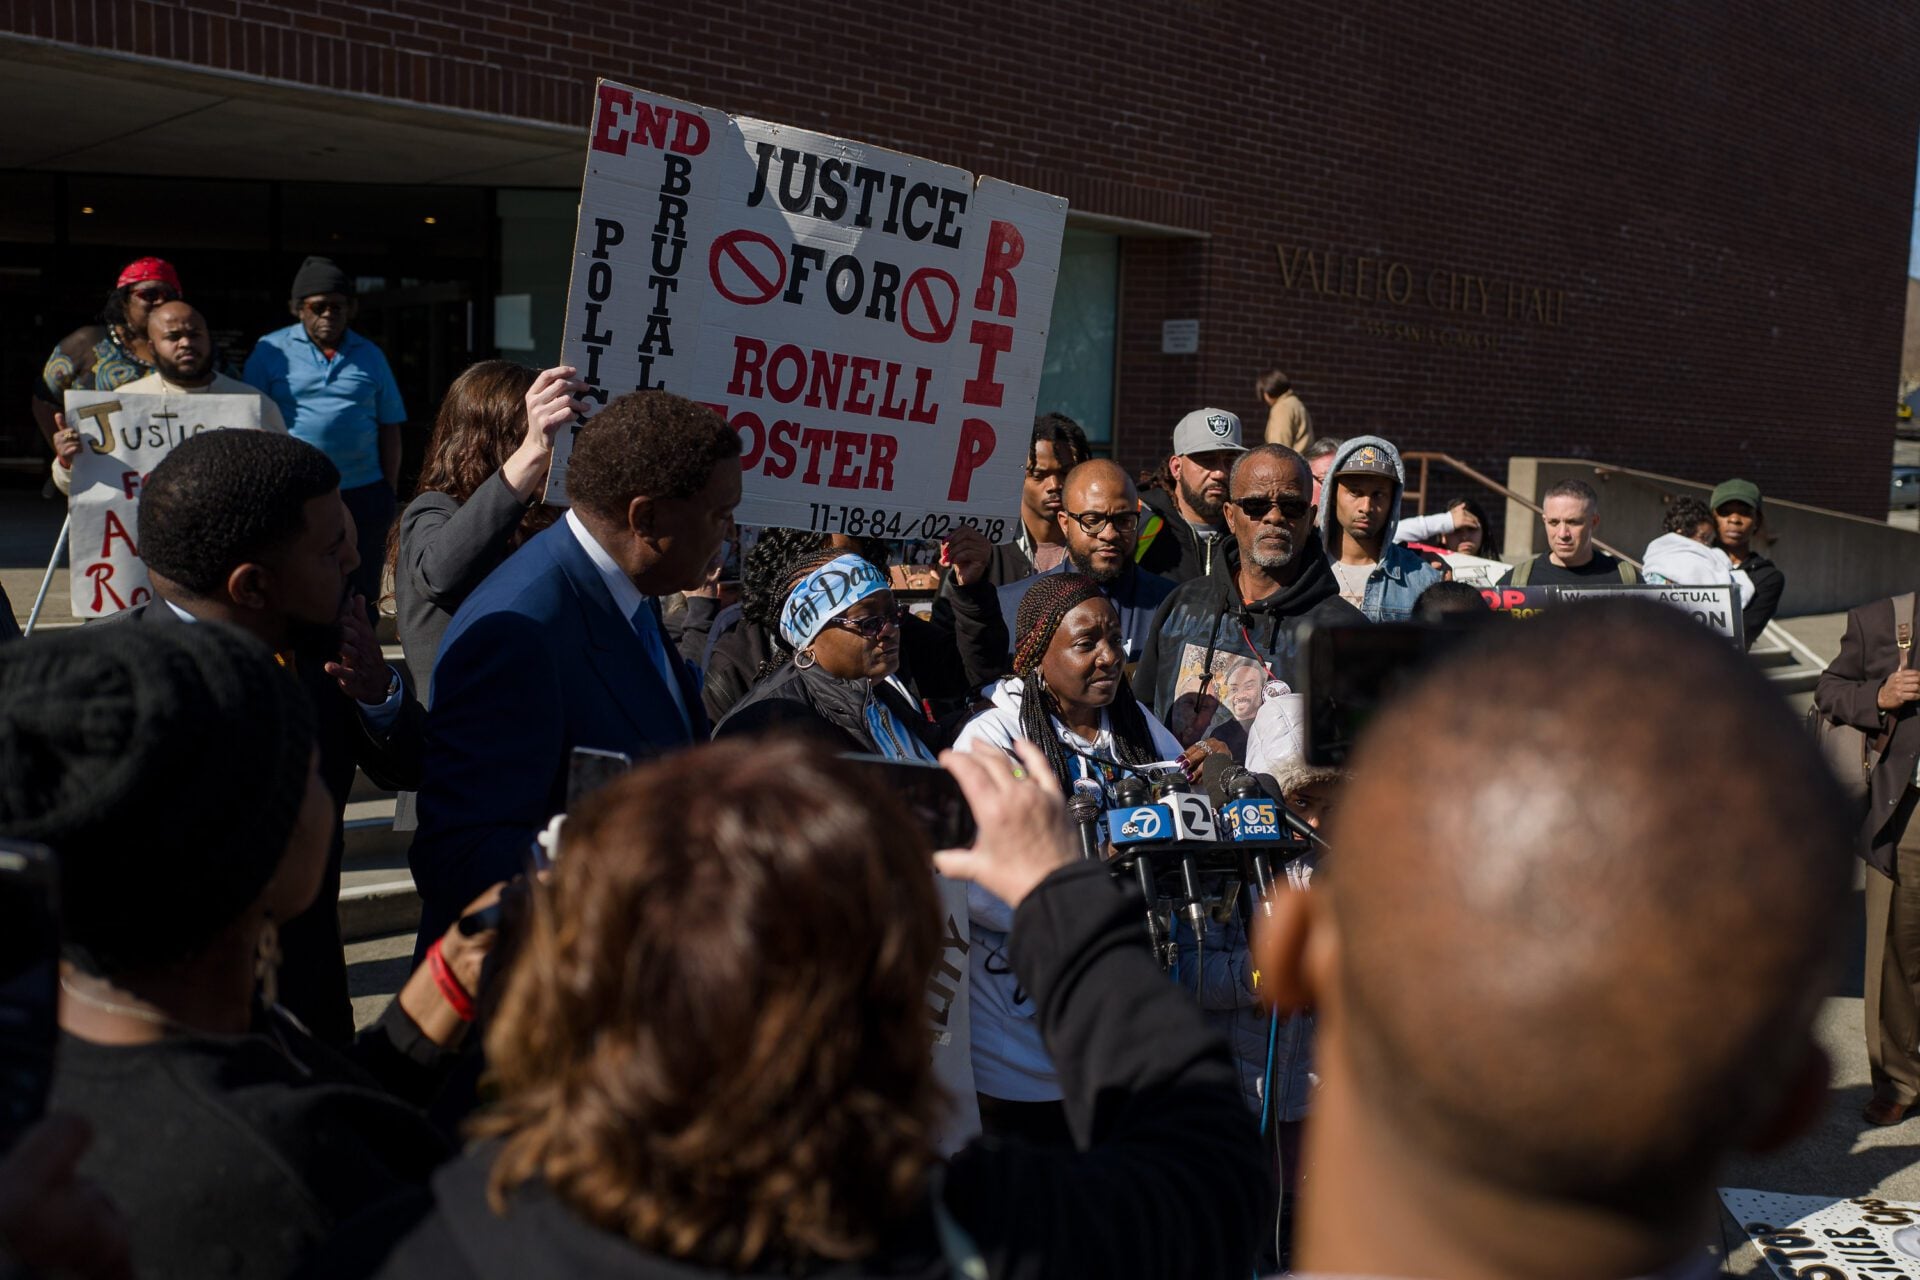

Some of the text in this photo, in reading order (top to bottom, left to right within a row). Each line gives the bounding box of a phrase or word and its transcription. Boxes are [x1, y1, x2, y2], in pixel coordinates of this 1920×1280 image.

[592, 84, 711, 156] END
[747, 142, 969, 249] JUSTICE
[782, 243, 901, 322] FOR
[1275, 244, 1569, 327] VALLEJO CITY HALL
[727, 335, 940, 425] RONELL
[699, 402, 899, 492] OSTER
[1659, 592, 1721, 603] ACTUAL
[1121, 823, 1139, 834] abc
[1130, 812, 1159, 837] 7
[1181, 800, 1212, 836] 2
[1229, 805, 1240, 828] 5
[1244, 825, 1277, 835] KPIX
[1258, 804, 1276, 825] 5
